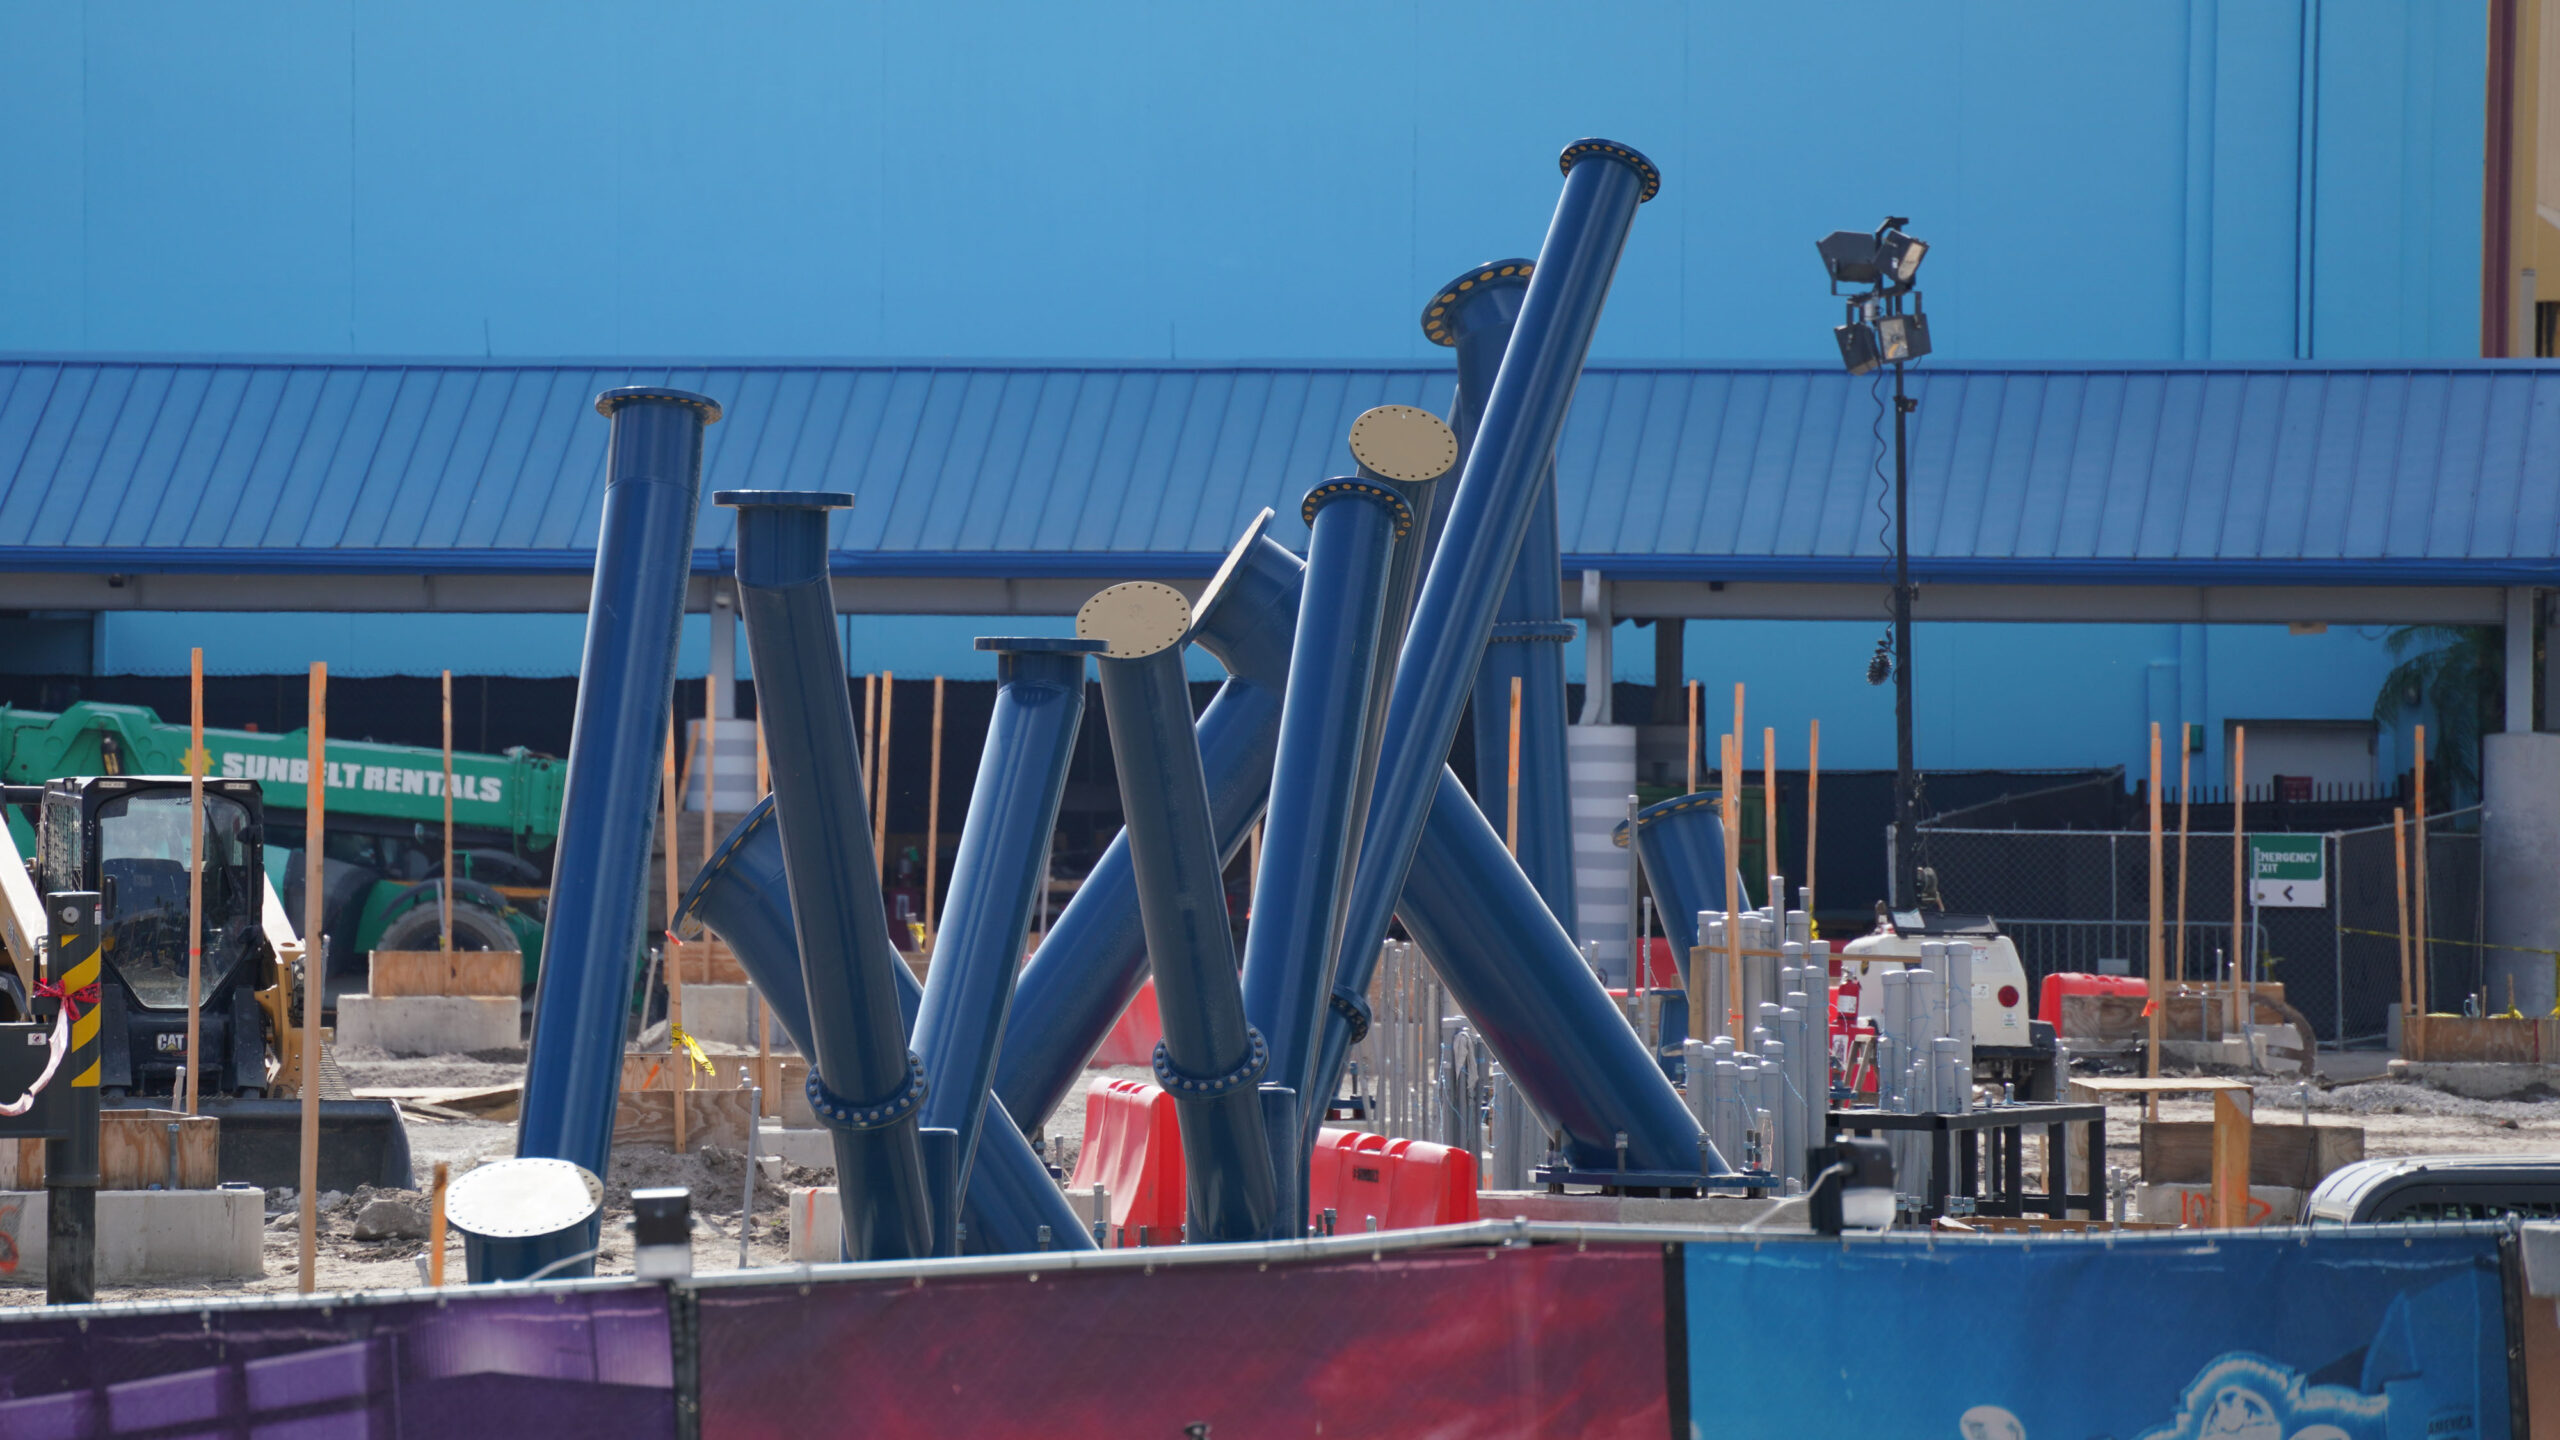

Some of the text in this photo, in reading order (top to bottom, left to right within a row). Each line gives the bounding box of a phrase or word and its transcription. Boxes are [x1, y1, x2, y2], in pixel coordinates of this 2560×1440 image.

[222, 752, 502, 802] SUNBLT RENTALS
[157, 1033, 184, 1051] CAT
